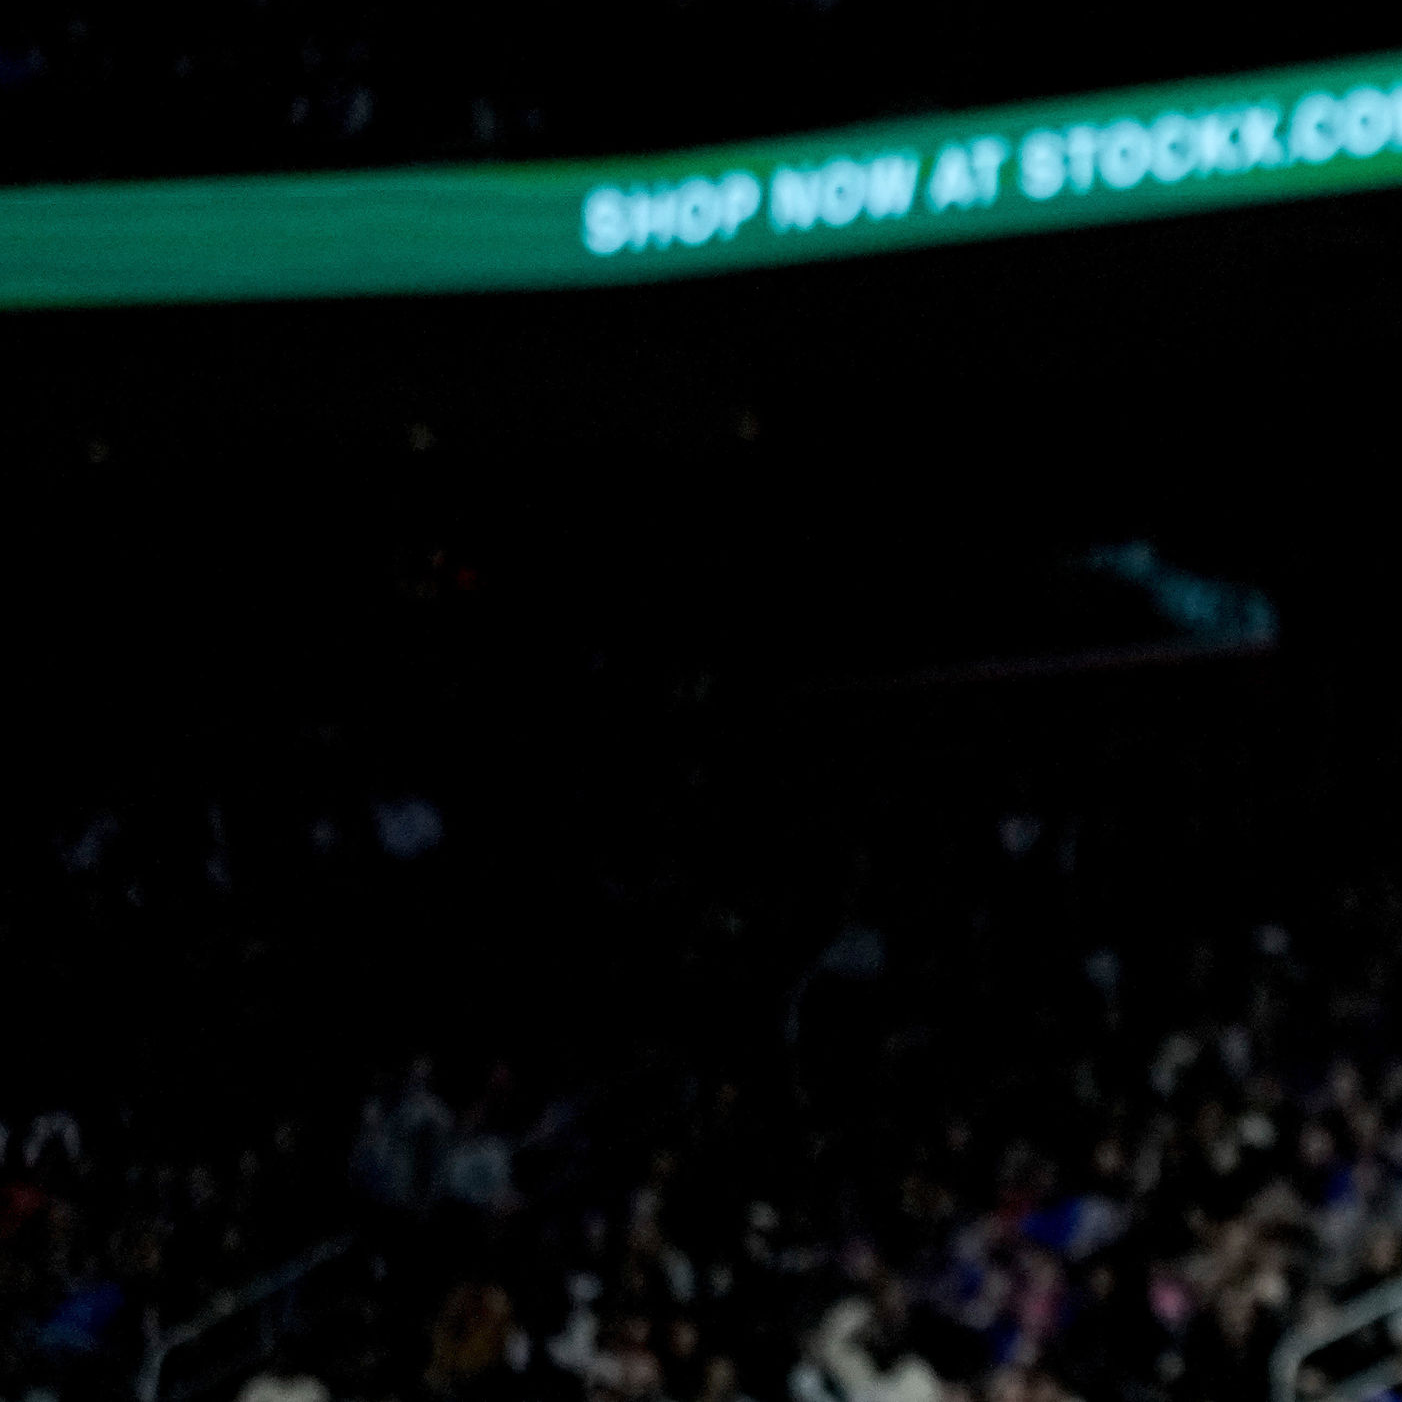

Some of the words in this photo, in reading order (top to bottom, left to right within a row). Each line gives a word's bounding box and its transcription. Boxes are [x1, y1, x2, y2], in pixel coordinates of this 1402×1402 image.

[580, 174, 760, 255] SHOP
[770, 151, 920, 231] NOW
[928, 138, 1011, 212] AT
